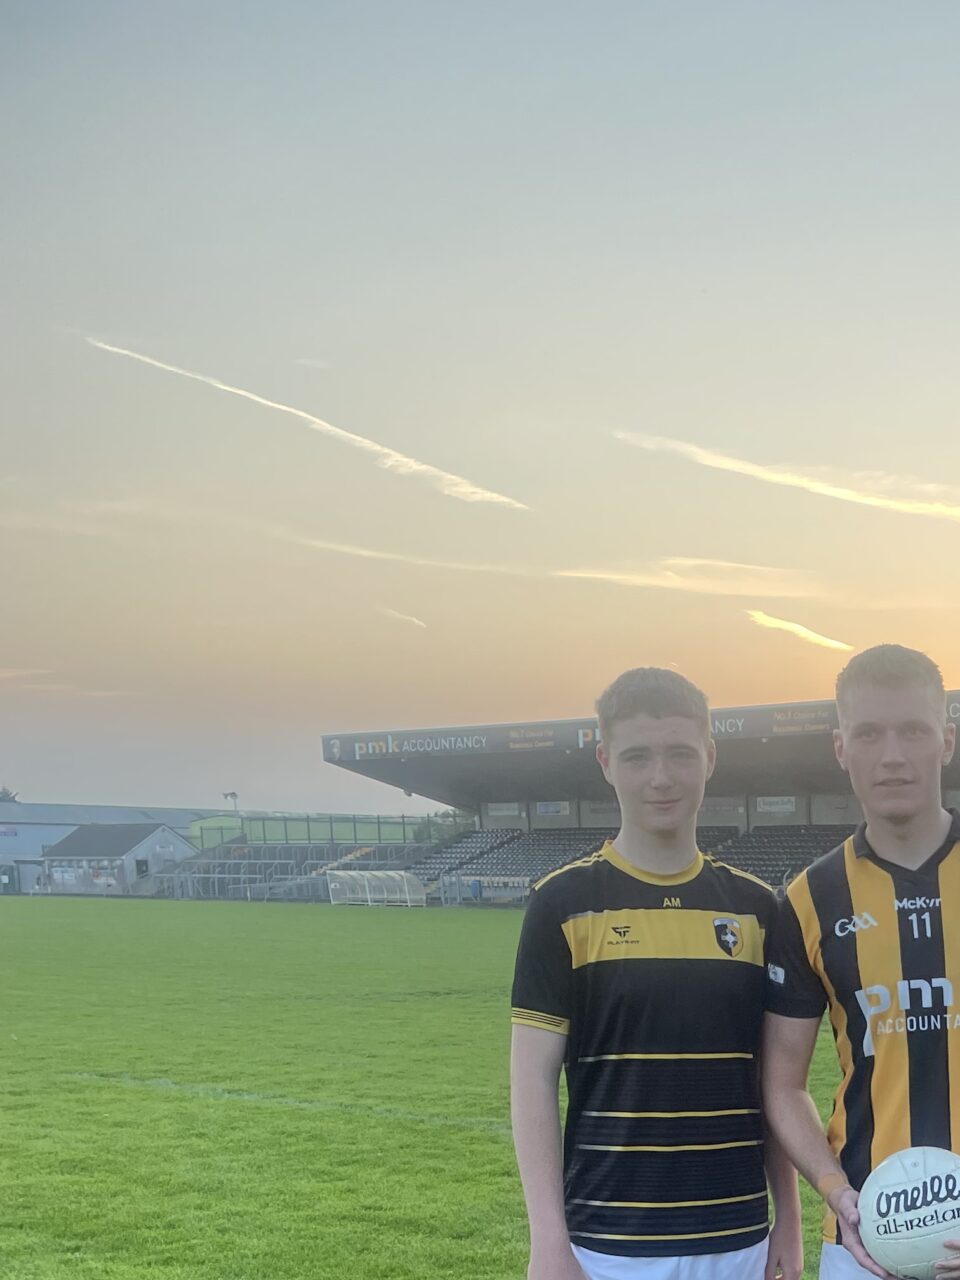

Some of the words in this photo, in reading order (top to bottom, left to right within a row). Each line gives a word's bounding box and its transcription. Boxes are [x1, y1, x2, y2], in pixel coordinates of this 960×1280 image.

[354, 734, 399, 760] pmk
[402, 735, 487, 752] ACCOUNTANCY
[663, 897, 681, 907] AM
[908, 912, 931, 938] 11
